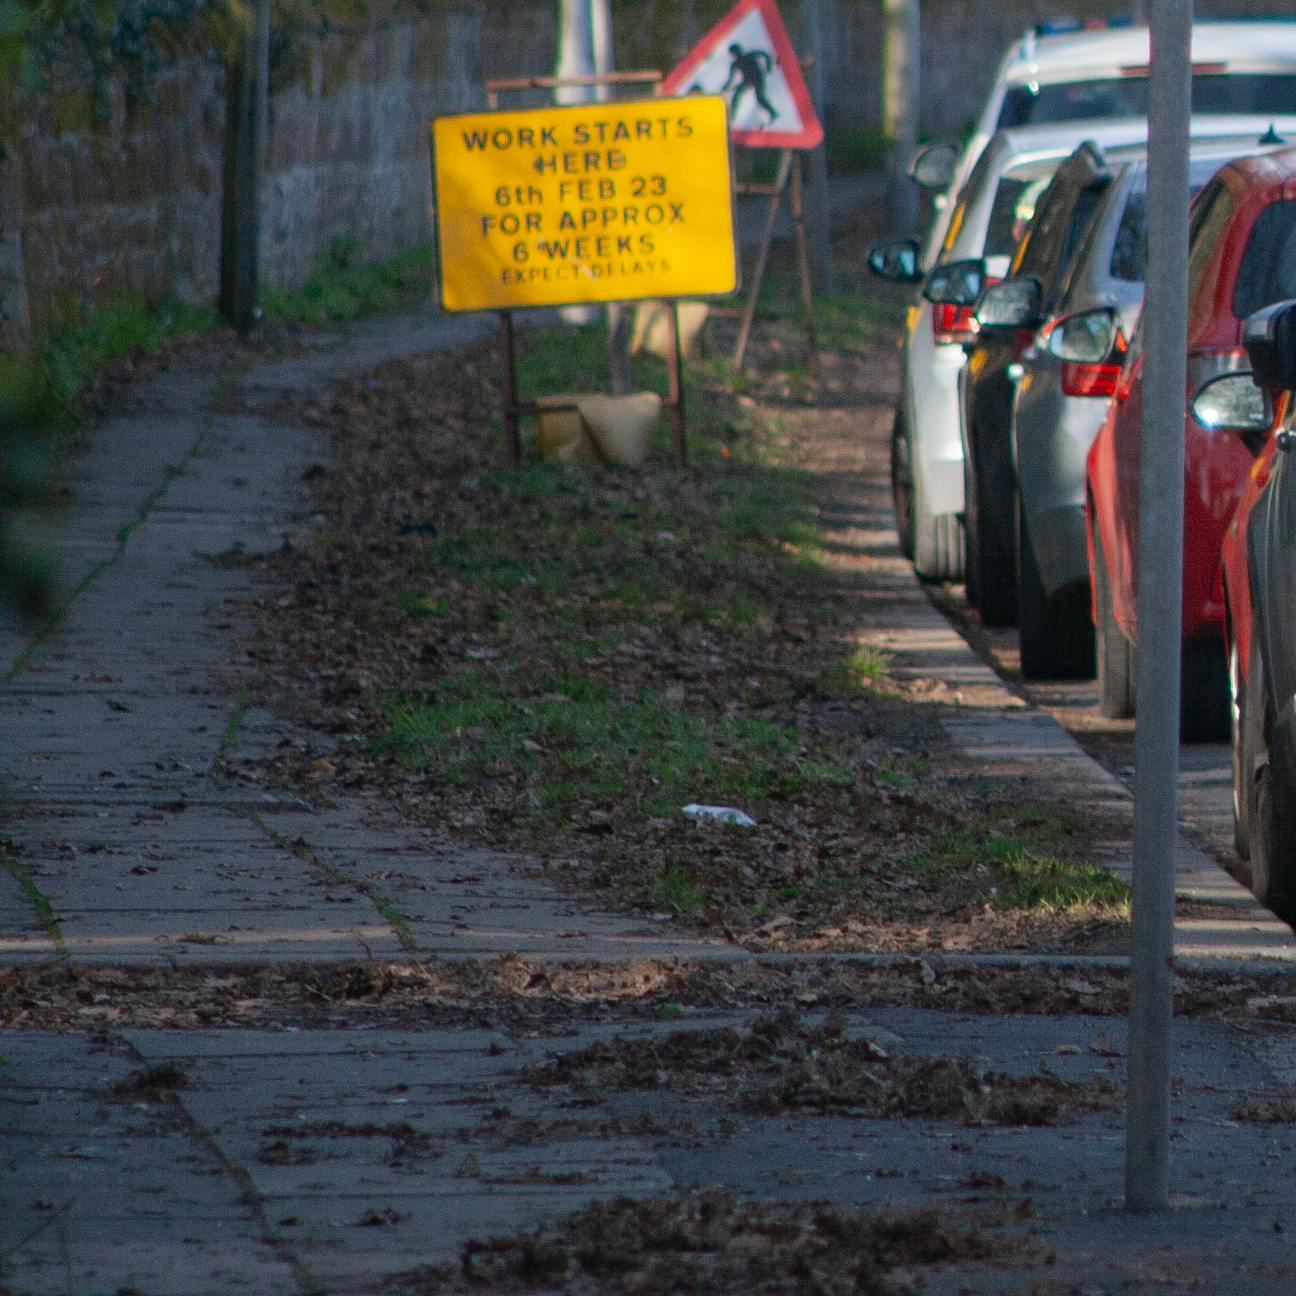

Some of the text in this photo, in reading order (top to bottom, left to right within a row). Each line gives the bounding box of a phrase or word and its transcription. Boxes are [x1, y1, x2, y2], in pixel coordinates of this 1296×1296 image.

[462, 118, 694, 151] WORK STARTS
[495, 176, 667, 207] 6th FEB 23
[481, 203, 686, 236] FOR APPROX
[513, 235, 656, 263] 6 WEEKS
[501, 260, 672, 284] EXPECT DELAYS
